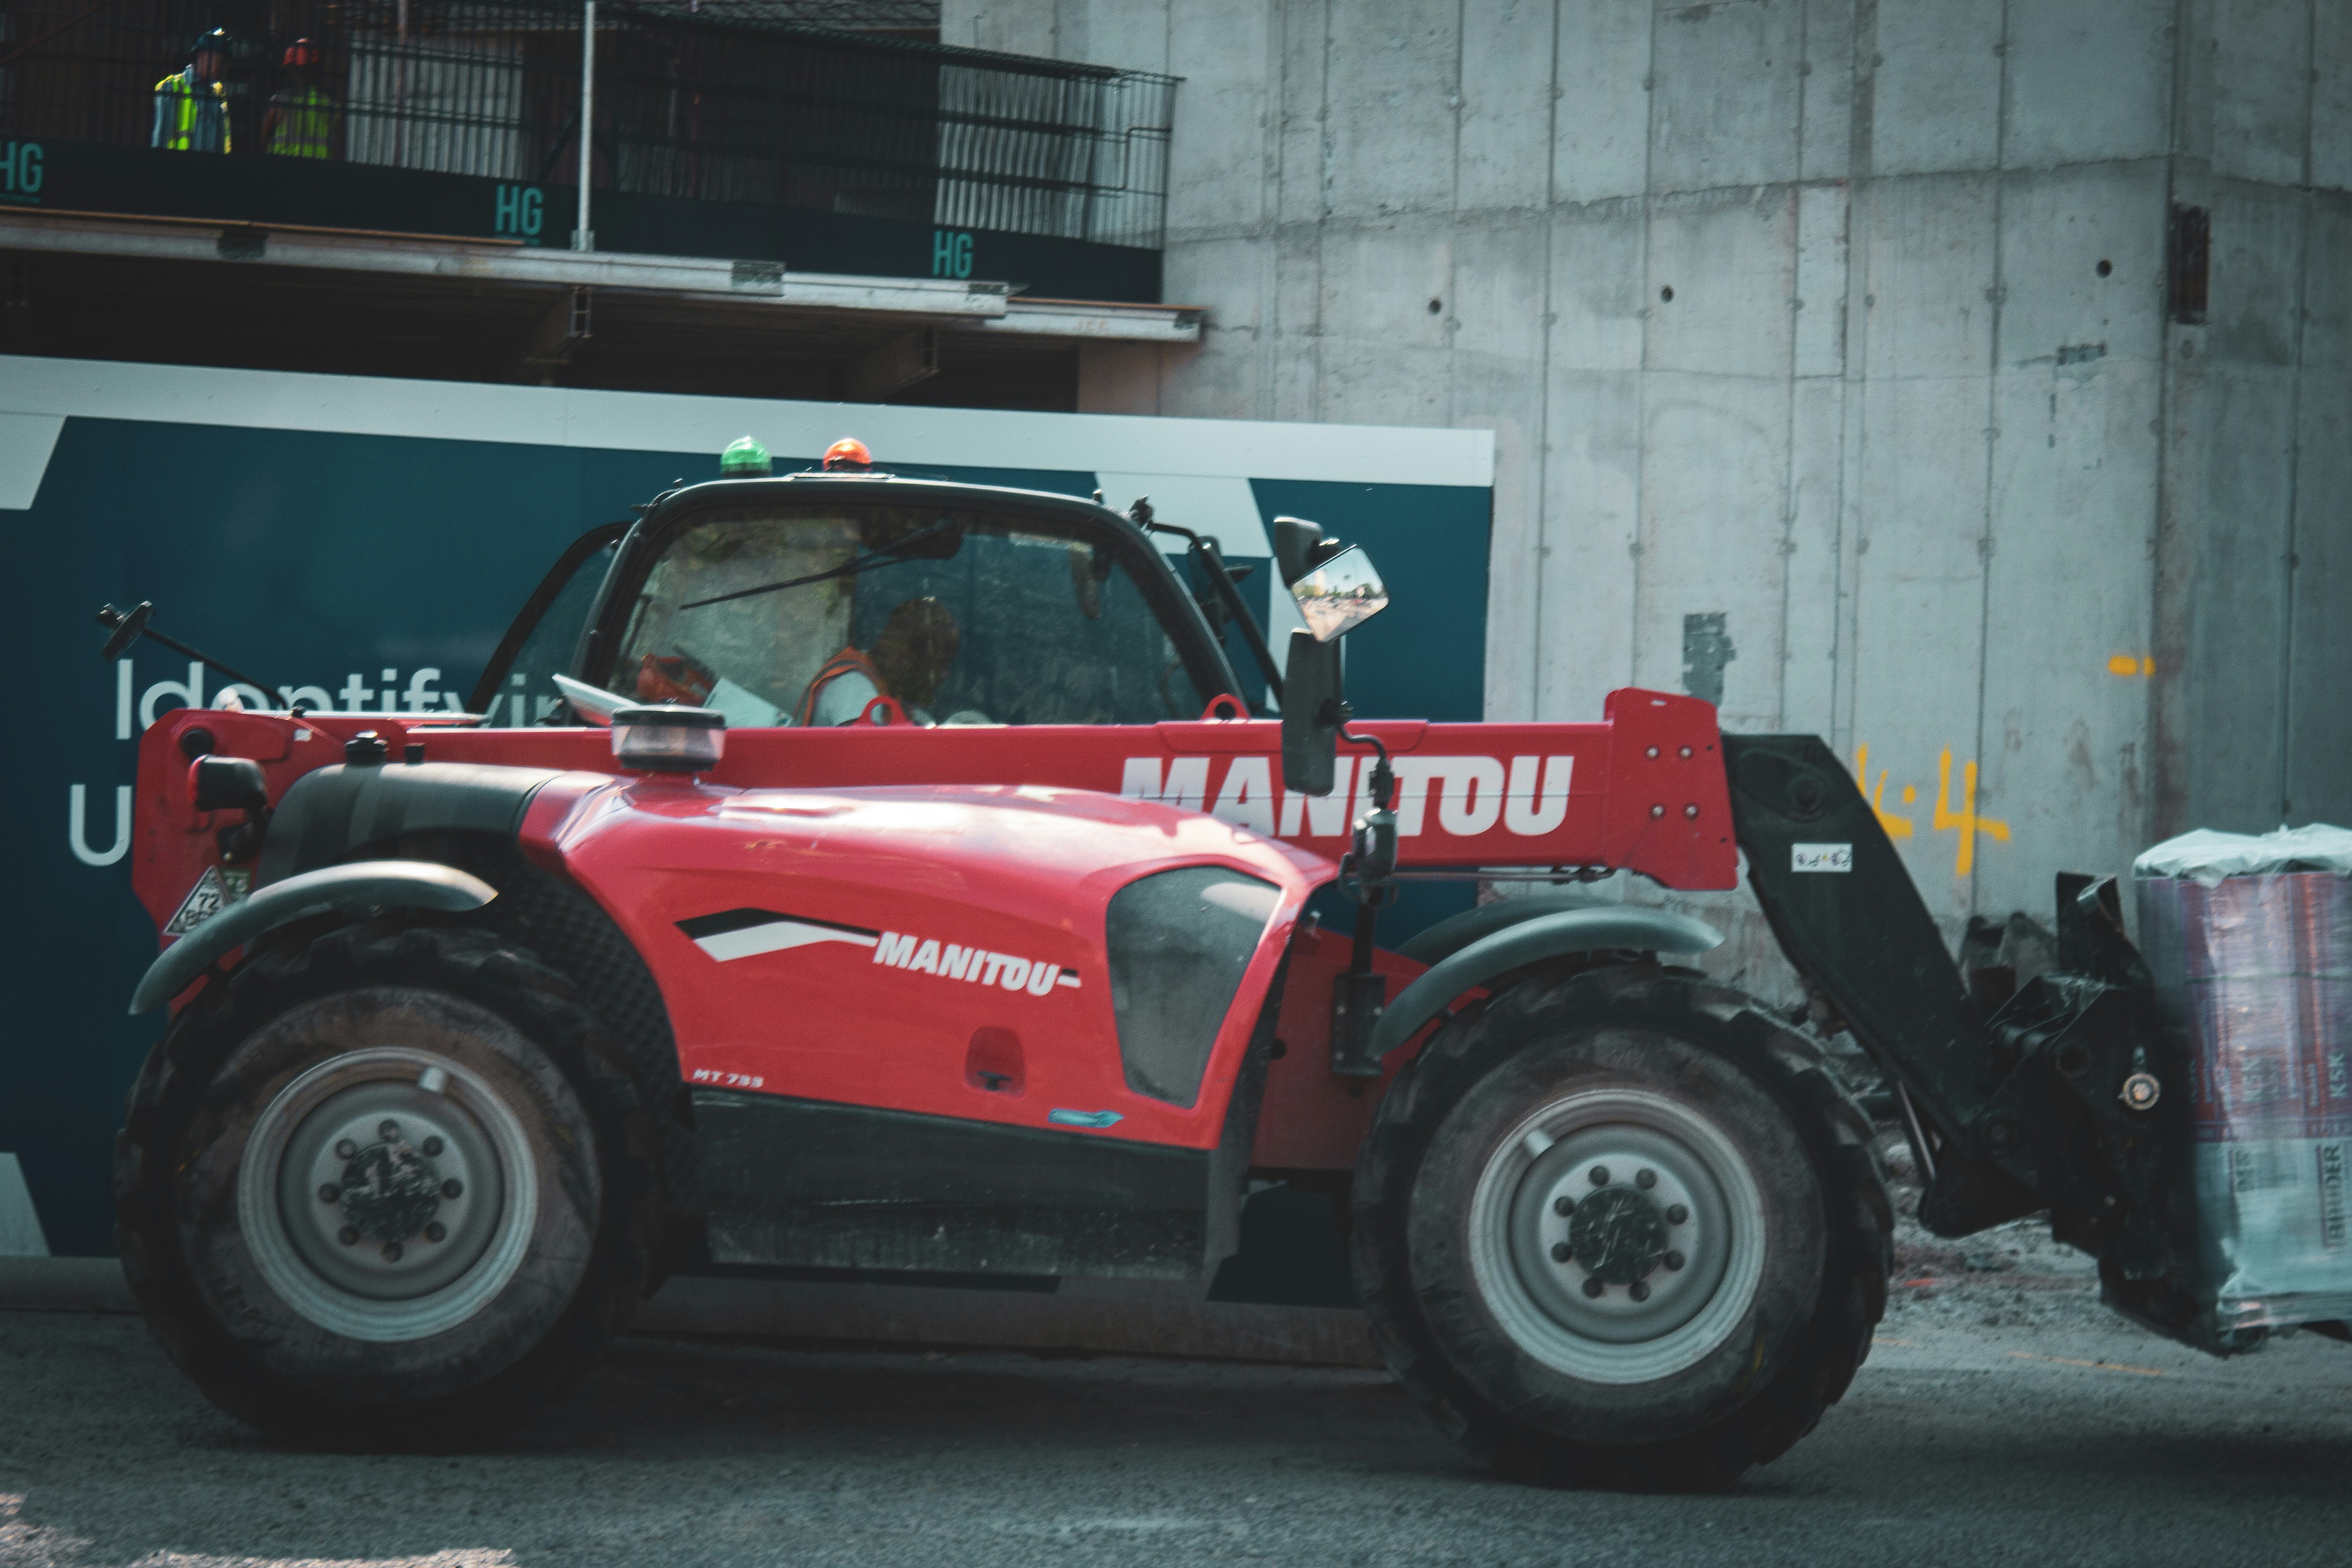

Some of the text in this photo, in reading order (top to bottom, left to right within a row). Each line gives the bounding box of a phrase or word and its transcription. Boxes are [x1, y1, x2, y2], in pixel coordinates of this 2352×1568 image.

[0, 141, 44, 194] HG
[495, 184, 544, 235] HG
[932, 230, 974, 279] HG
[873, 931, 1060, 997] MANITOU
[693, 1069, 724, 1082] MT
